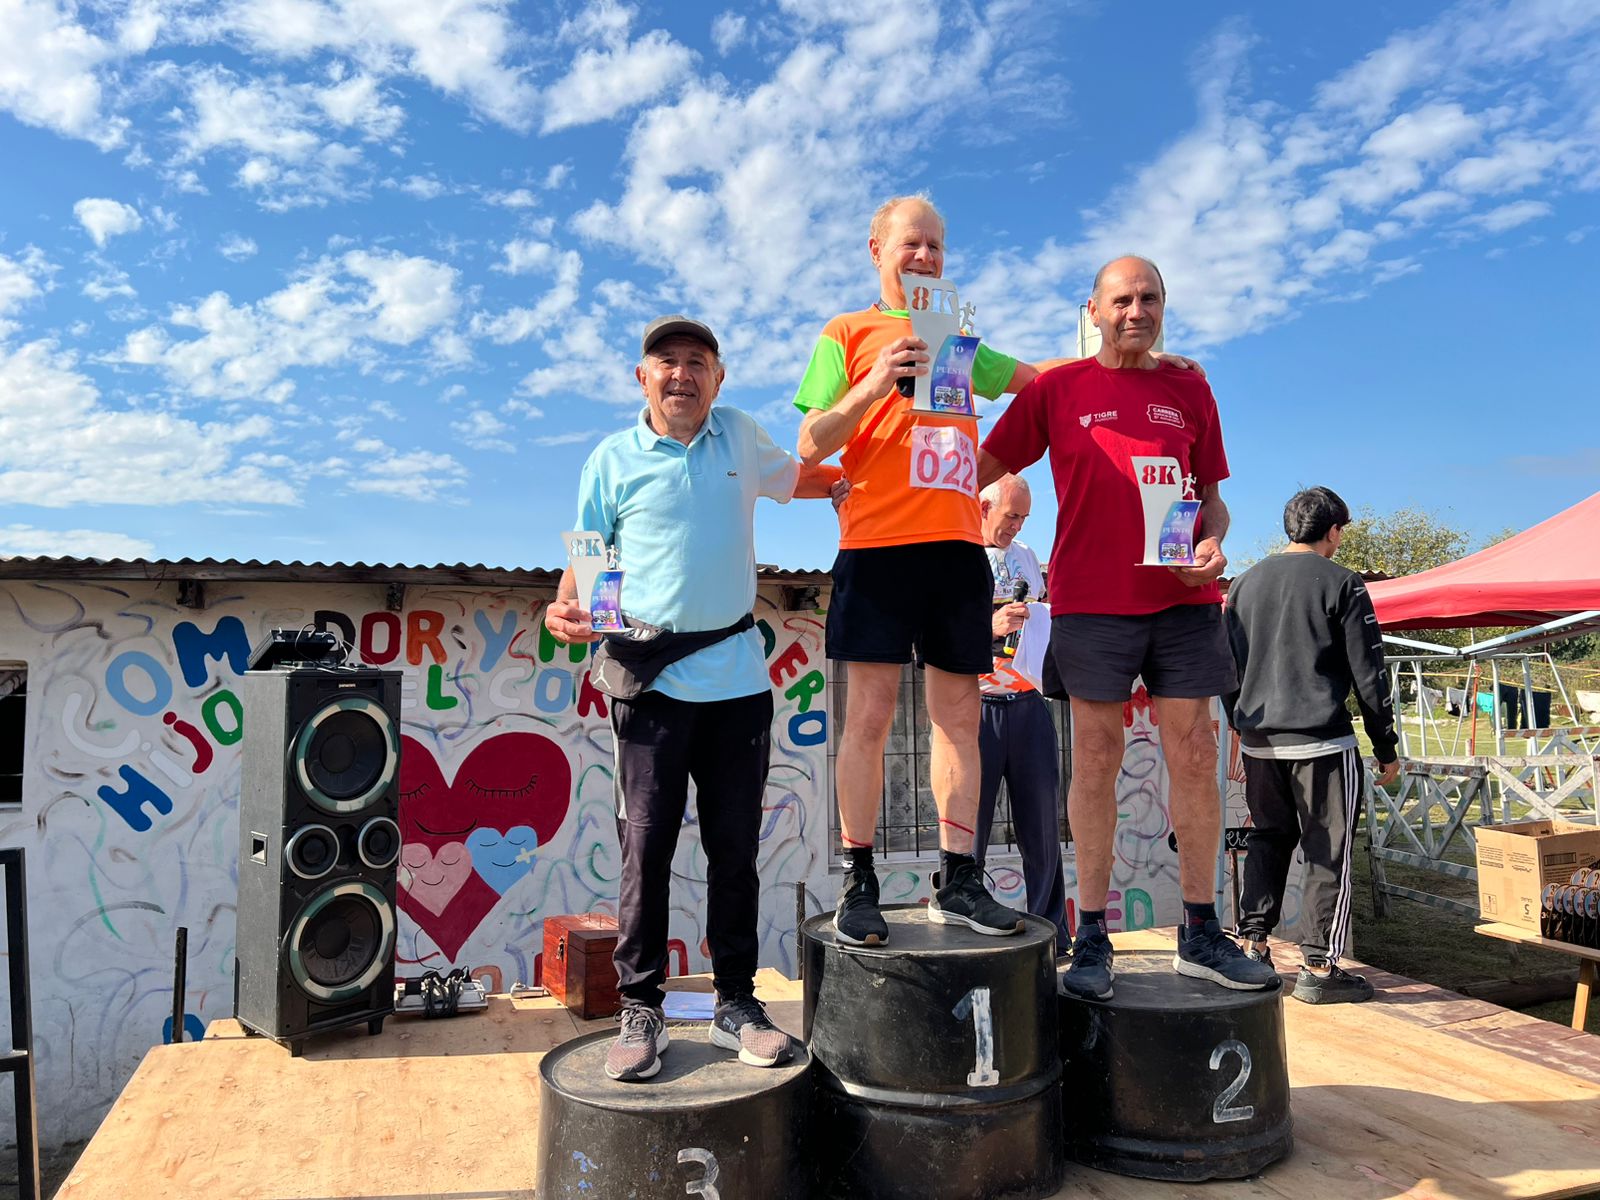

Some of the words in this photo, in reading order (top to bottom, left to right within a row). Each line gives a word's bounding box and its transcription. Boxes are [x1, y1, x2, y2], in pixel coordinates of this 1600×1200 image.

[911, 286, 956, 315] 8K
[1093, 410, 1118, 419] TIGRE
[916, 448, 973, 491] 022
[1141, 464, 1176, 485] 8K
[571, 538, 601, 557] 8K
[473, 609, 517, 673] Y
[951, 985, 1000, 1088] 1
[1208, 1038, 1255, 1125] 2
[677, 1147, 720, 1200] 3
